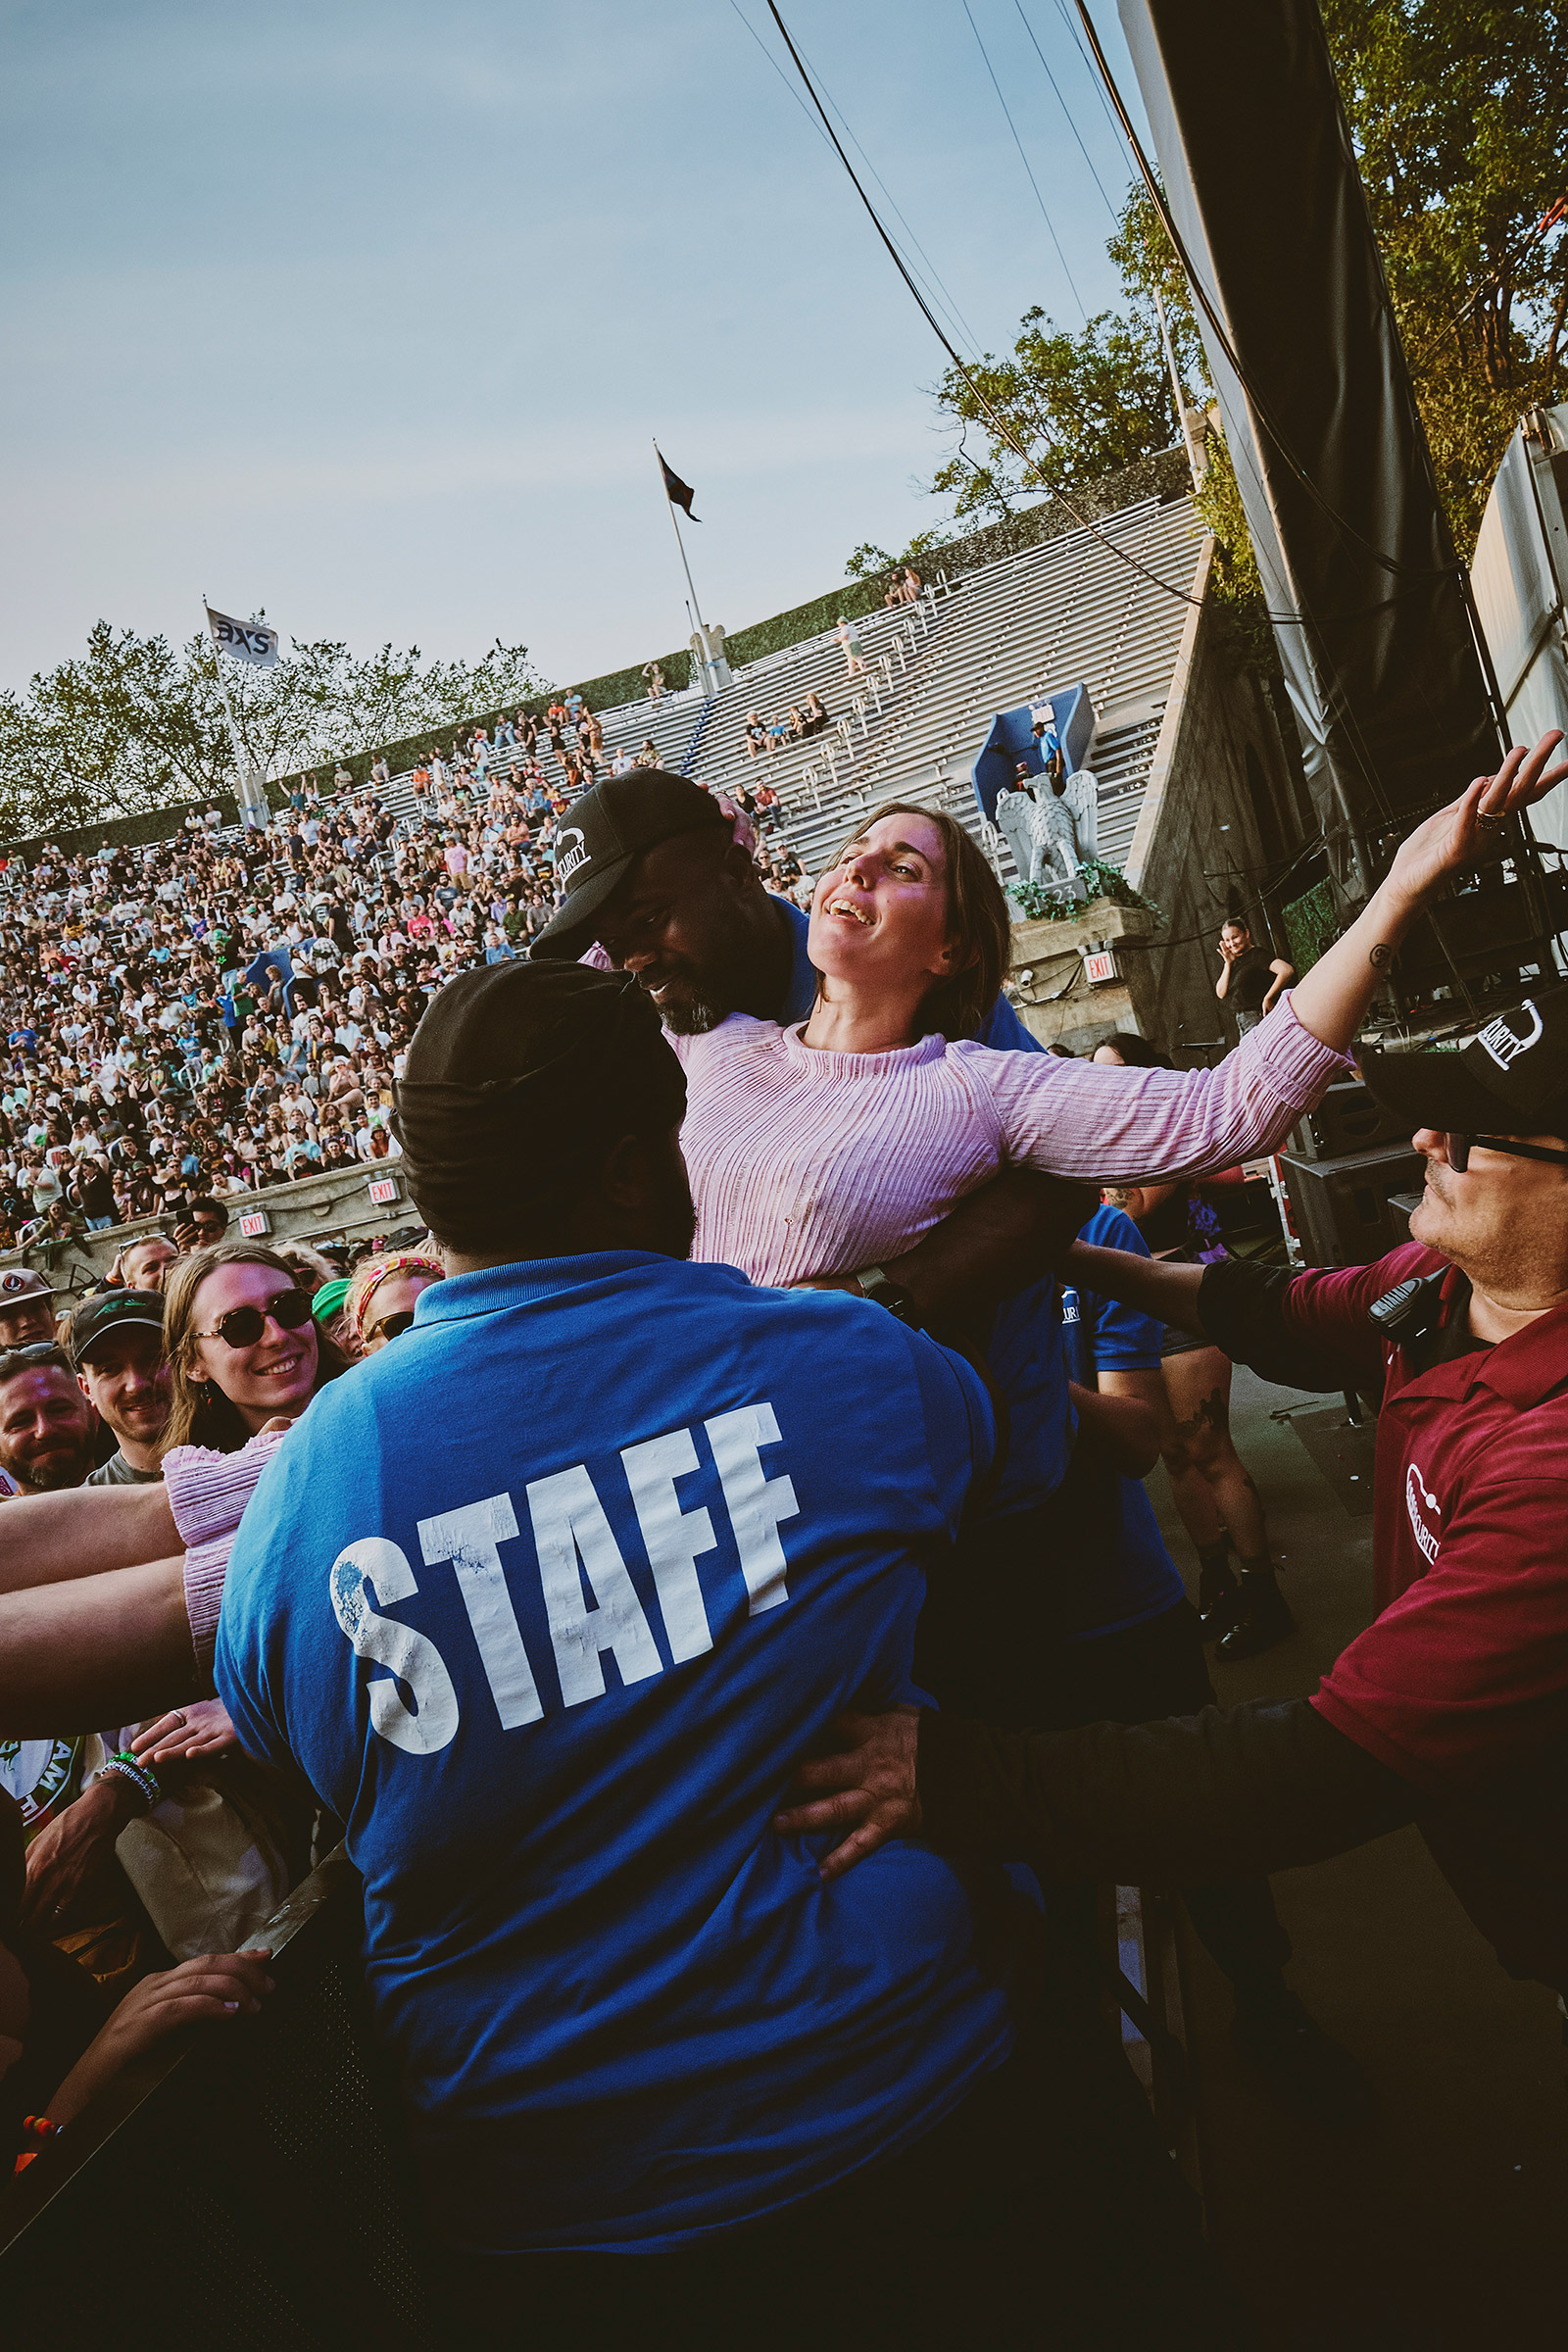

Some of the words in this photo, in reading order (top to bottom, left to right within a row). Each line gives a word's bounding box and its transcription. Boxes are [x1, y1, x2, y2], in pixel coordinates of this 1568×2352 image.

[1089, 956, 1109, 979] EXIT
[371, 1181, 392, 1201] EXIT
[242, 1215, 263, 1235] EXIT
[329, 1401, 801, 1755] STAFF
